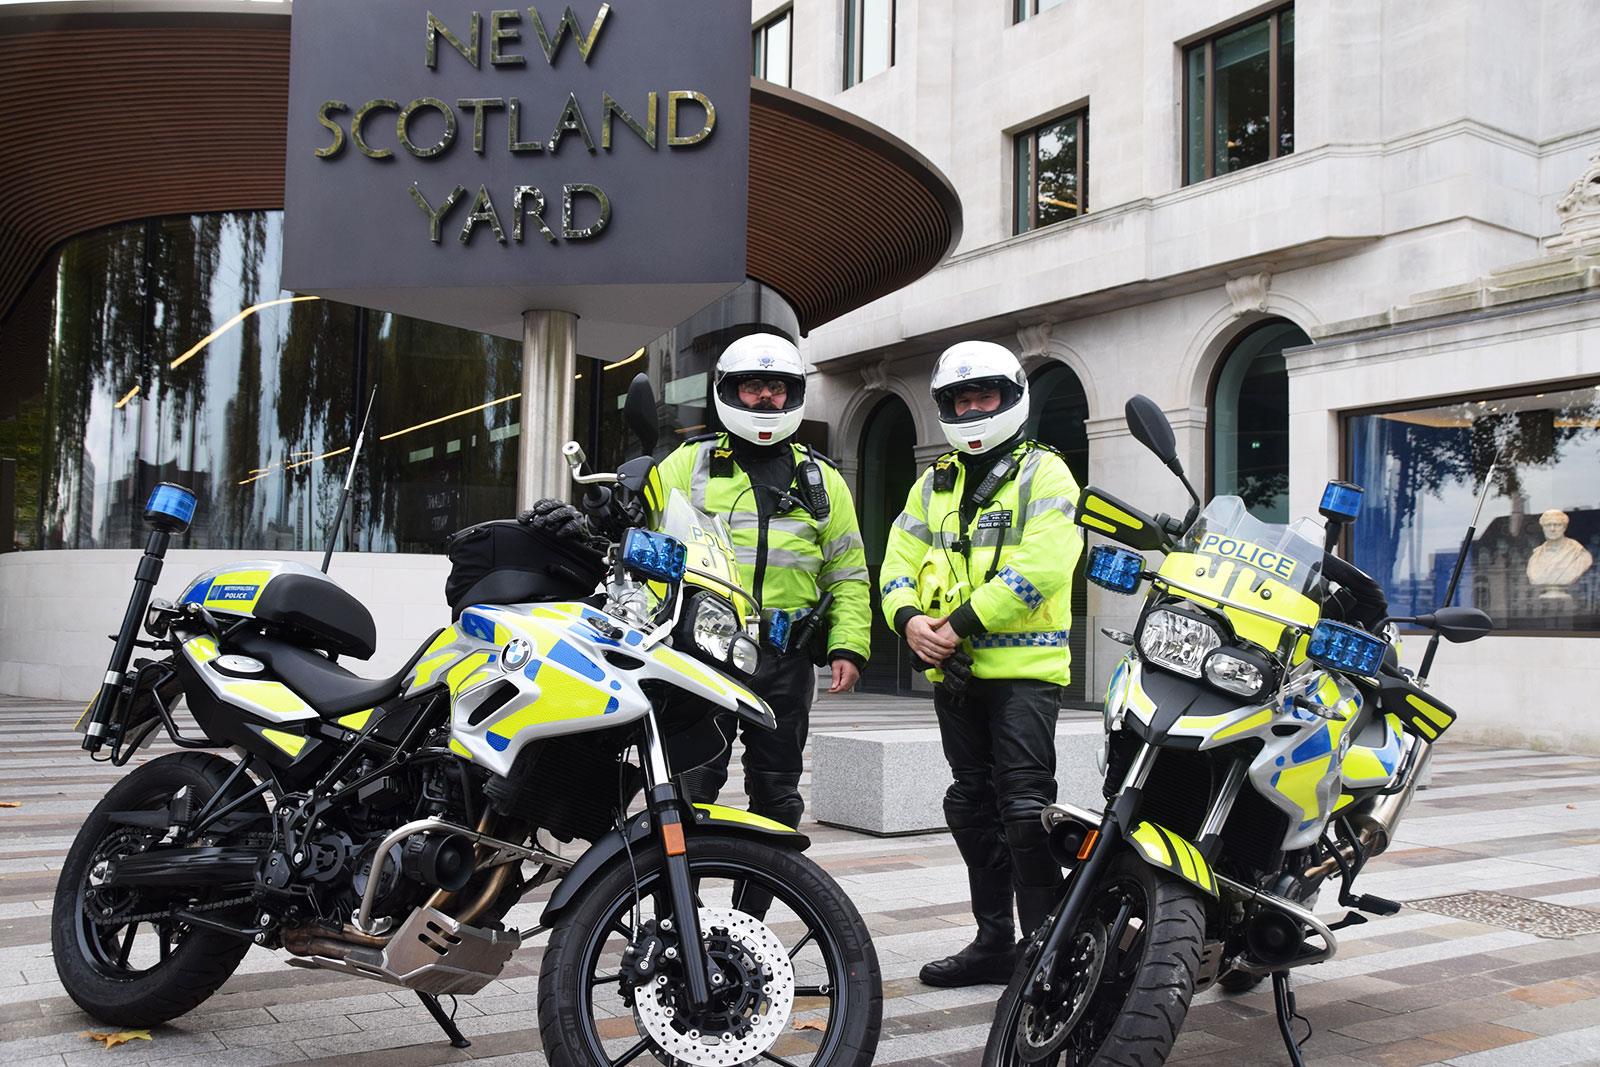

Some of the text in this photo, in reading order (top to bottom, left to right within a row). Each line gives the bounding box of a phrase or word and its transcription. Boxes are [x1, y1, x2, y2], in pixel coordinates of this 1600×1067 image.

[425, 4, 612, 70] NEW
[313, 90, 717, 159] SCOTLAND
[408, 181, 612, 244] YARD
[1202, 535, 1294, 578] POLICE
[224, 592, 248, 600] POLICE
